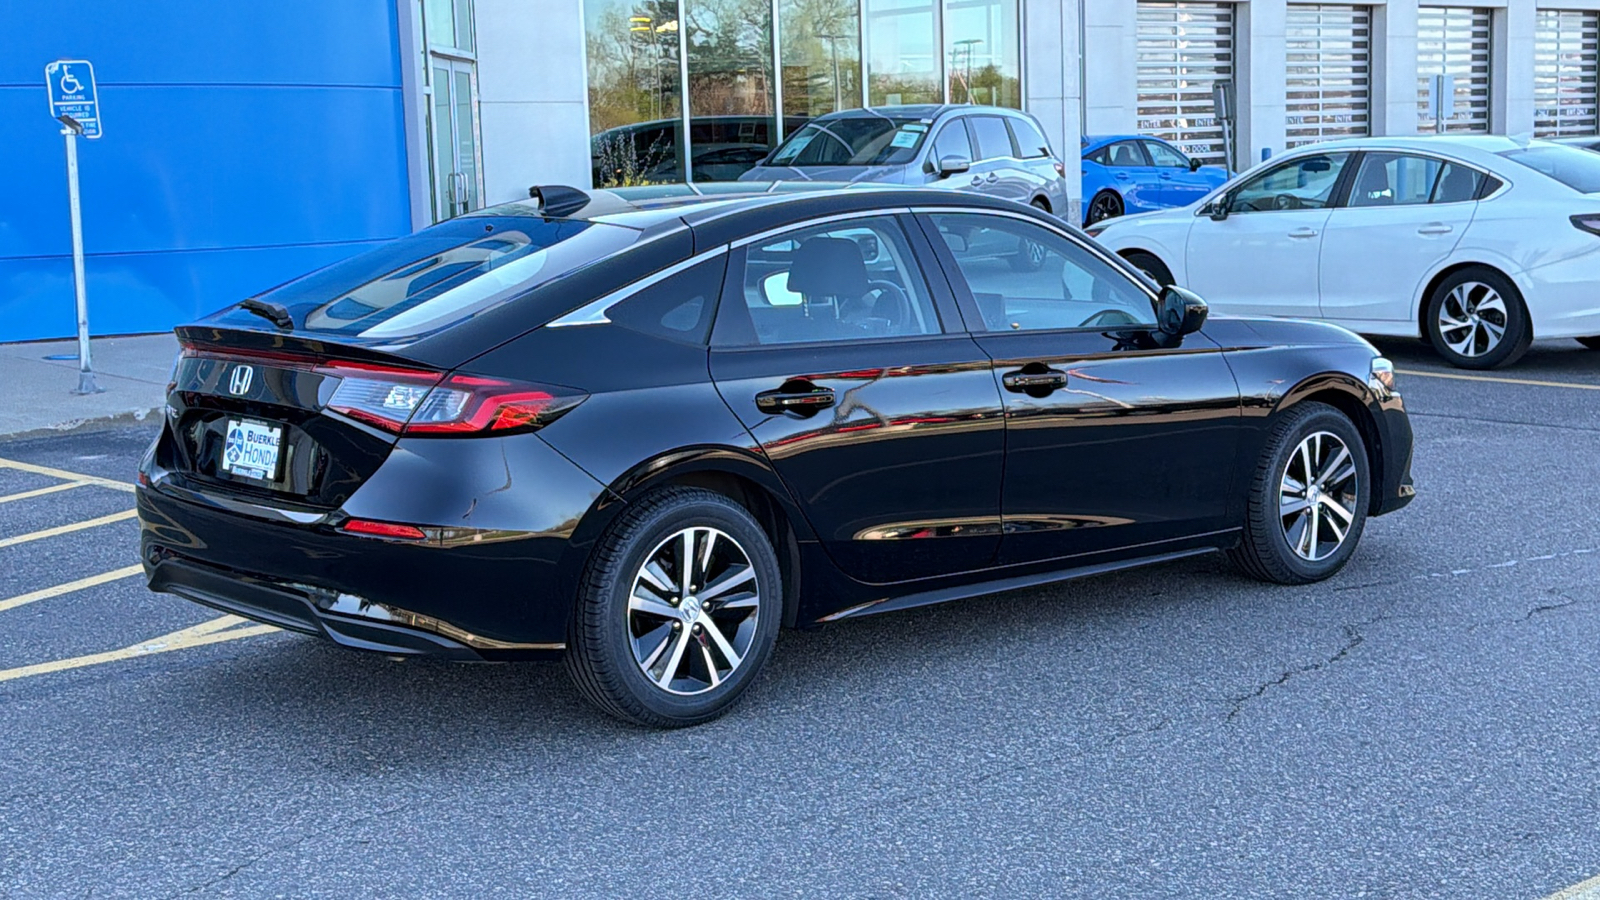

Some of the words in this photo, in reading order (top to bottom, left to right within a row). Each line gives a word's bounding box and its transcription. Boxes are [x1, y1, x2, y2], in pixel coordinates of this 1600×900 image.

[1140, 119, 1161, 129] ENTER
[1194, 118, 1215, 127] ENTER
[1191, 144, 1211, 153] DOOR
[243, 443, 278, 467] HONDA
